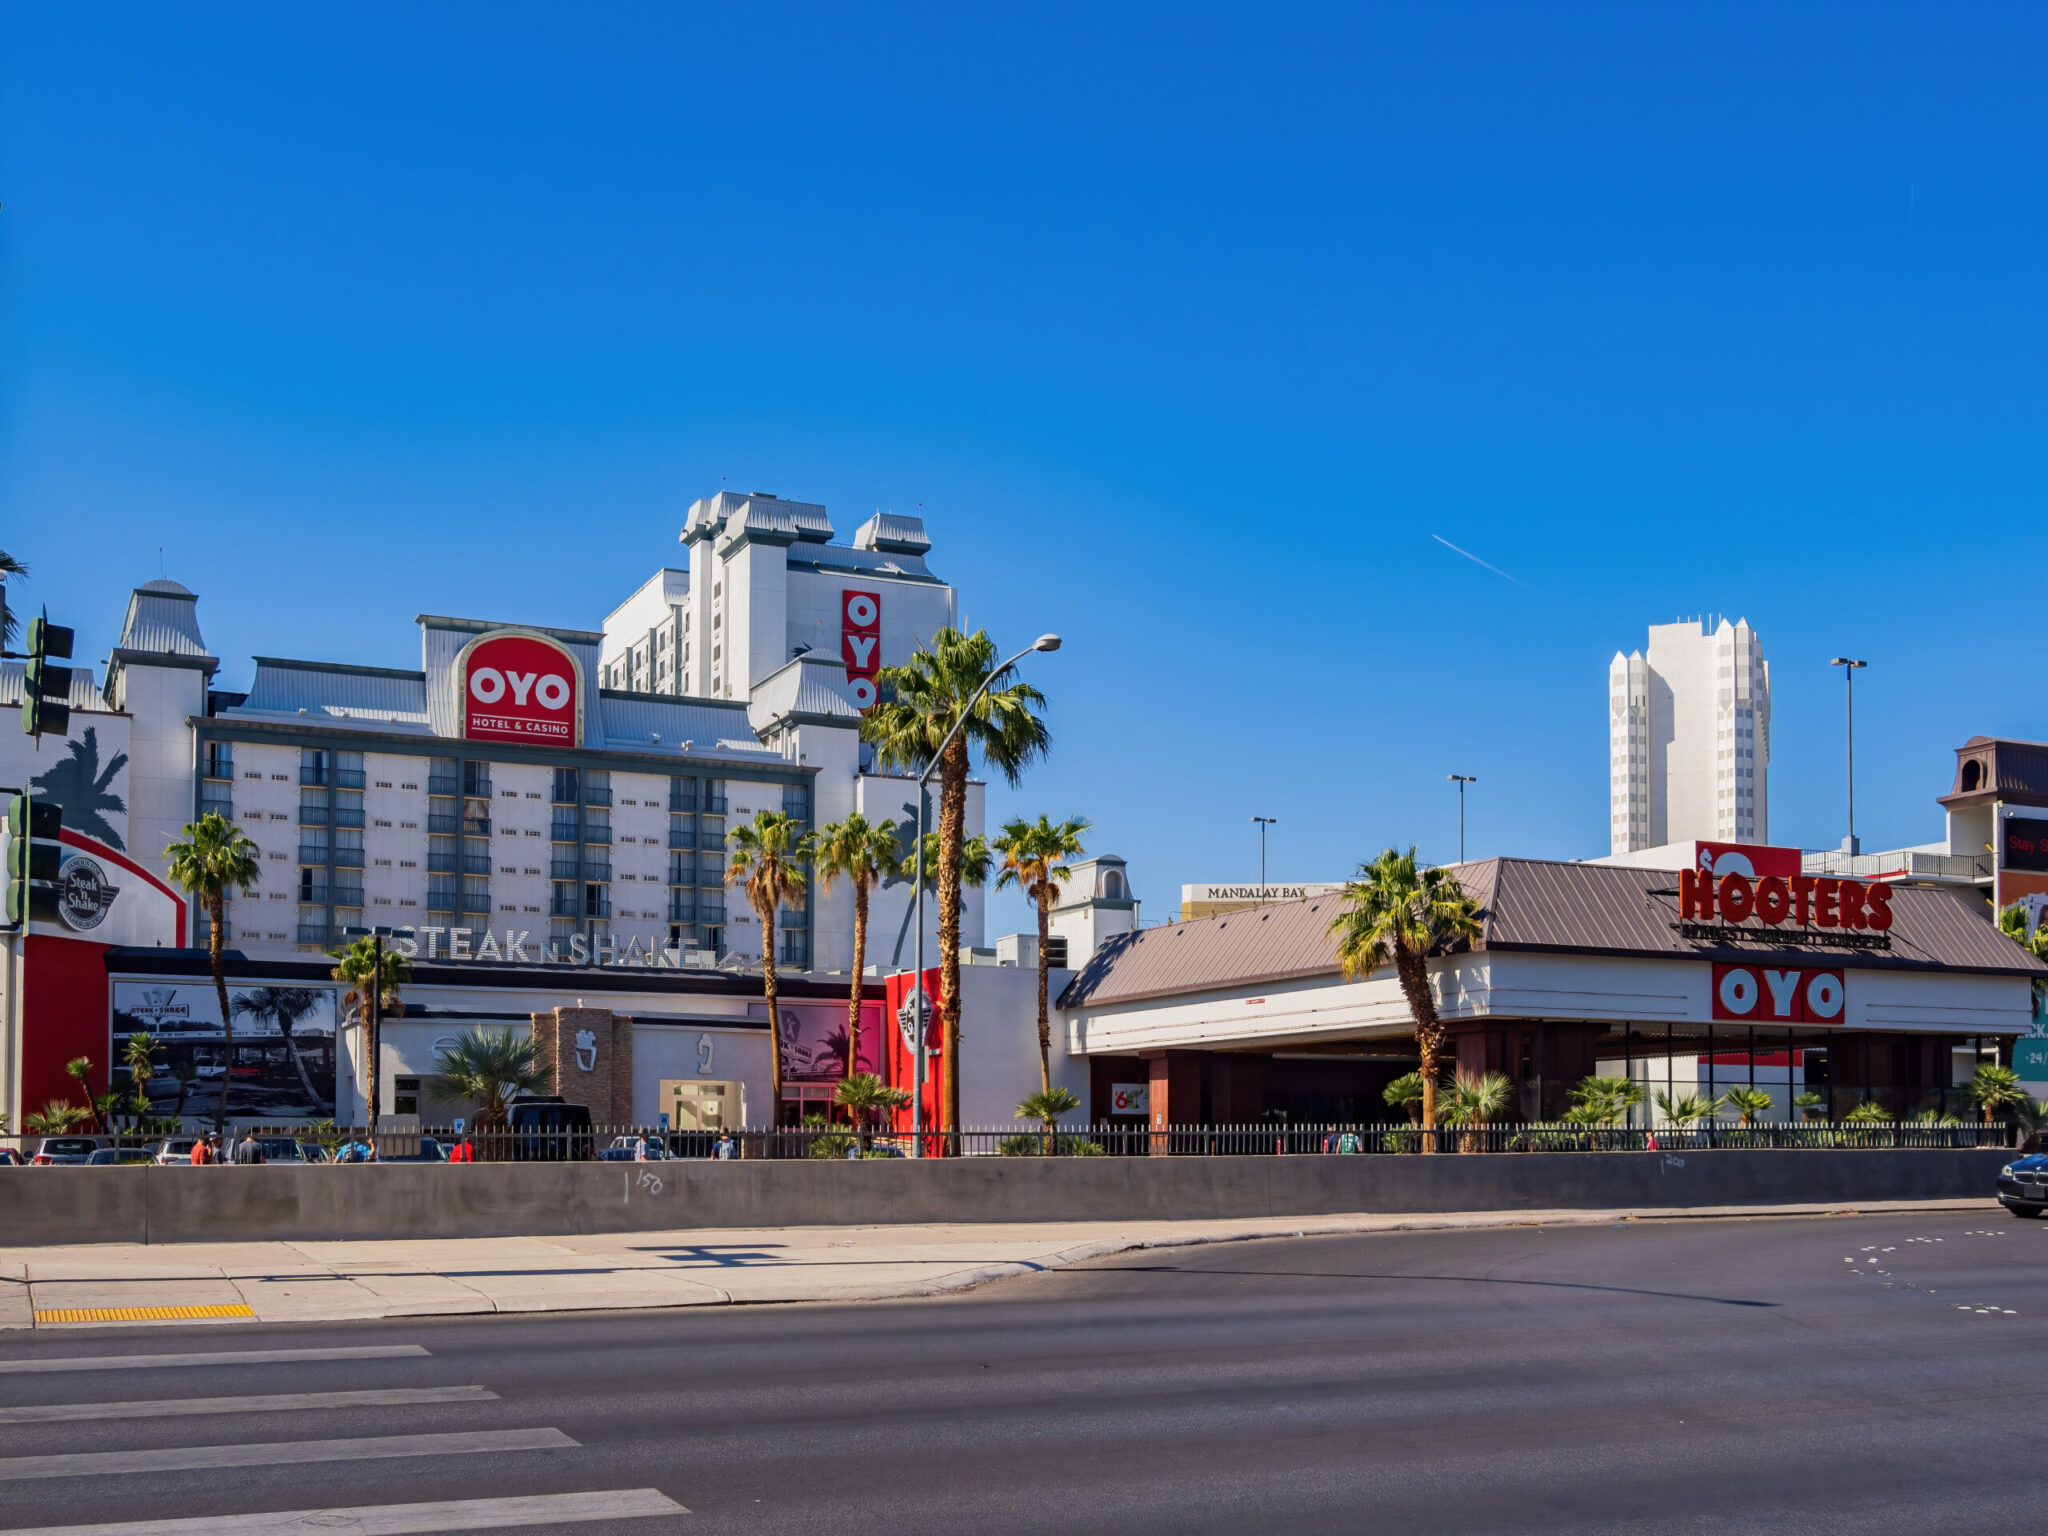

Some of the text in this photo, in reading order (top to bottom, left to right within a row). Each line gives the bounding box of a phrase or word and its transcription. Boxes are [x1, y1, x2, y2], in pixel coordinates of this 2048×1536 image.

[848, 595, 877, 709] OYO
[470, 667, 570, 710] OYO
[472, 717, 568, 734] HOTEL & CASINO
[2009, 835, 2036, 855] Stay
[70, 872, 98, 891] Steak
[1208, 887, 1306, 898] MANDALAY BAY
[68, 892, 99, 911] Shake
[1680, 868, 1893, 931] HOOTERS
[395, 925, 531, 963] STEAK
[570, 932, 699, 968] SHAKE
[1720, 968, 1844, 1018] OYO
